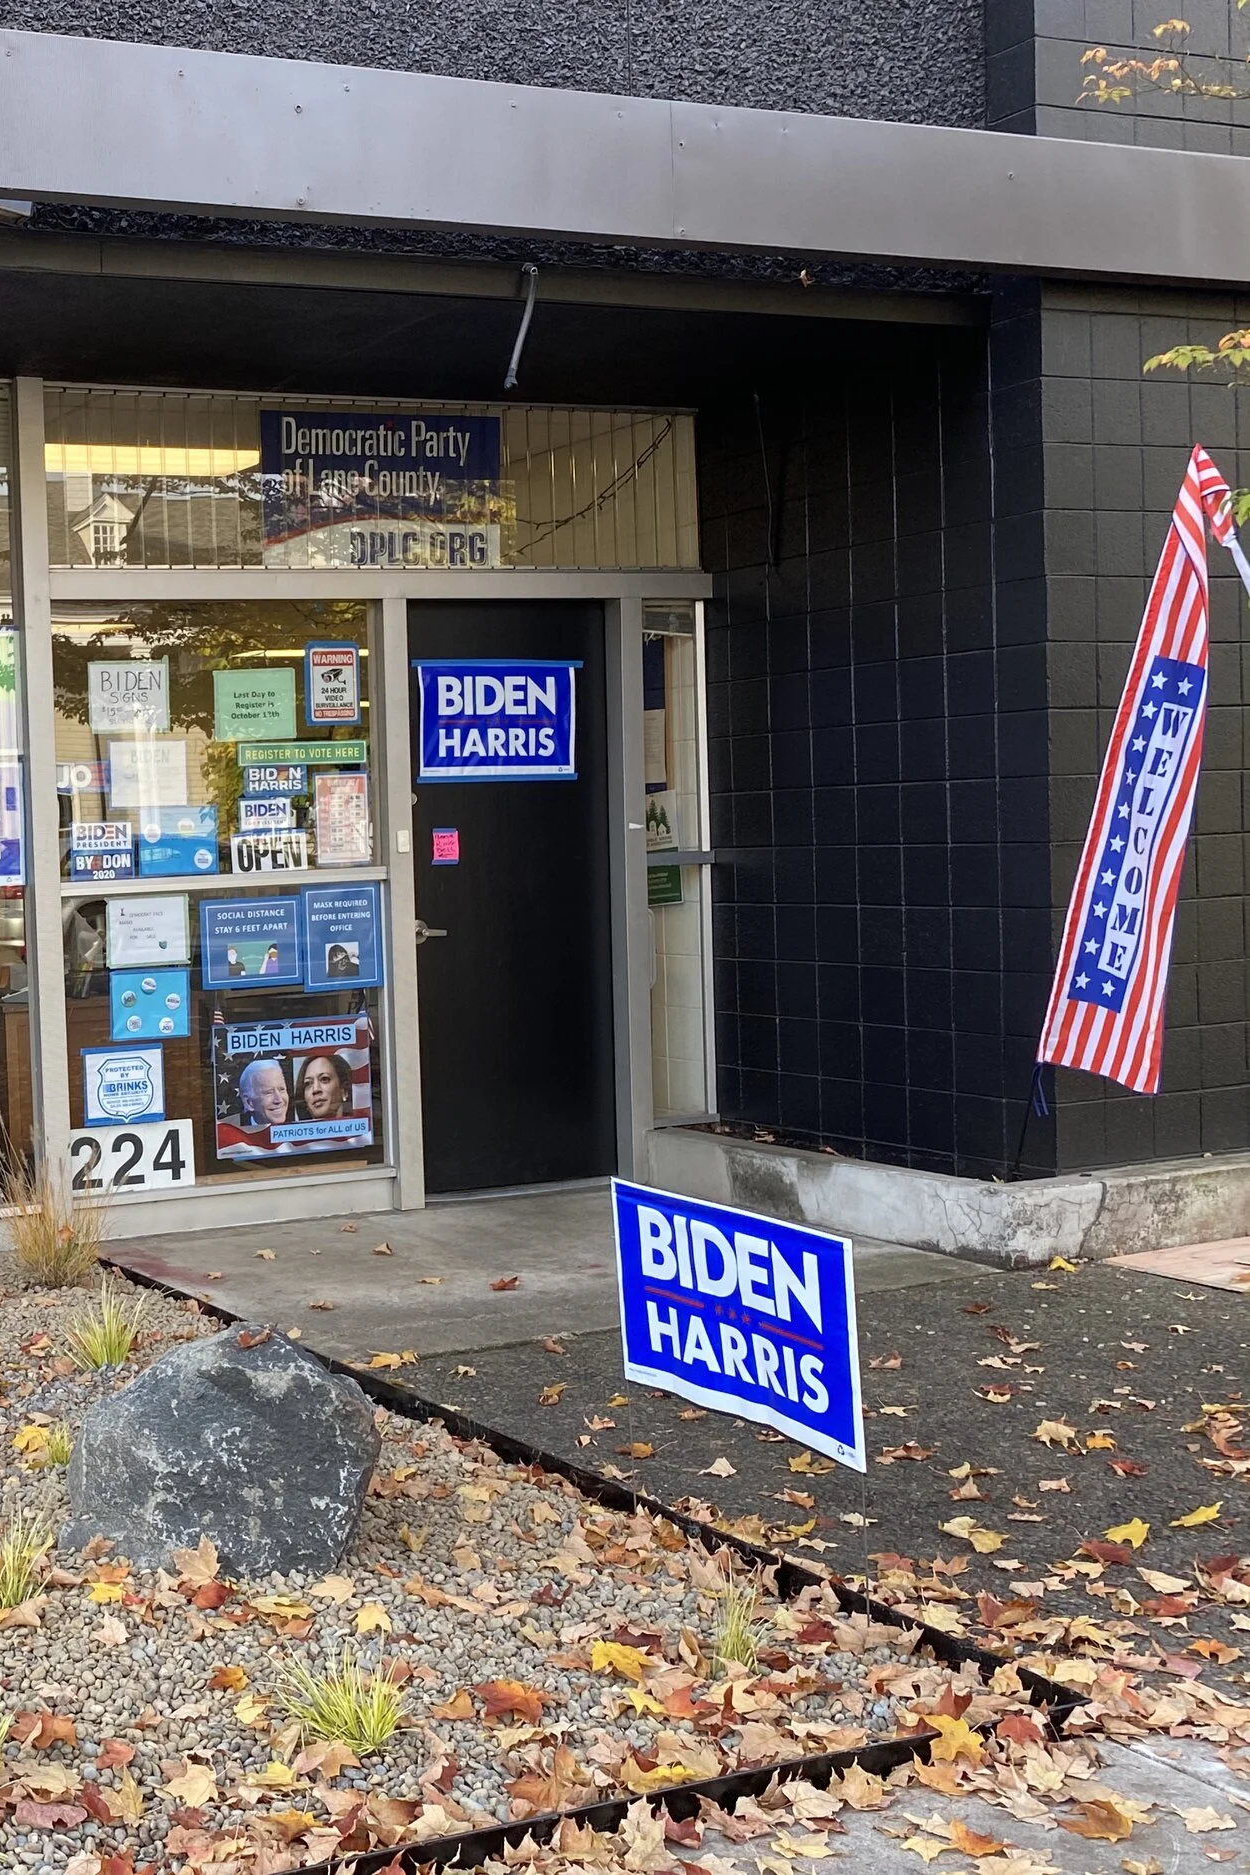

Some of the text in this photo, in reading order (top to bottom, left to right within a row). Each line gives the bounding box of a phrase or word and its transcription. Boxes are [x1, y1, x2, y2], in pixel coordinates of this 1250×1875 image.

[281, 416, 470, 466] Democratic Party
[283, 458, 440, 508] of Lane County
[313, 654, 353, 665] WARNING
[100, 670, 162, 692] BIDEN
[109, 692, 149, 703] SIGNS
[252, 691, 266, 699] Day
[324, 694, 344, 702] VIDEO
[437, 676, 556, 716] BIDEN
[235, 701, 266, 709] Register
[231, 711, 260, 719] October
[438, 727, 555, 757] HARRIS
[245, 747, 359, 760] REGISTER TO VOTE HERE
[249, 780, 302, 791] HARRIS
[245, 803, 287, 817] BIDEN
[76, 824, 127, 841] BIDEN
[1105, 708, 1190, 973] WELCOME
[237, 837, 302, 873] OPEN
[93, 870, 115, 880] 2020
[335, 899, 368, 907] REQUIRED
[217, 909, 285, 920] SOCIAL DISTANCE
[338, 911, 371, 919] ENTERING
[215, 923, 288, 934] STAY 6 FEET APART
[329, 924, 352, 932] OFFICE
[231, 1027, 352, 1049] BIDEN HARRIS
[110, 1081, 148, 1092] BRINKS
[273, 1122, 366, 1138] PATRIOTS for ALL of US
[70, 1129, 186, 1190] 224
[637, 1204, 823, 1335] BIDEN
[646, 1300, 830, 1414] HARRIS
